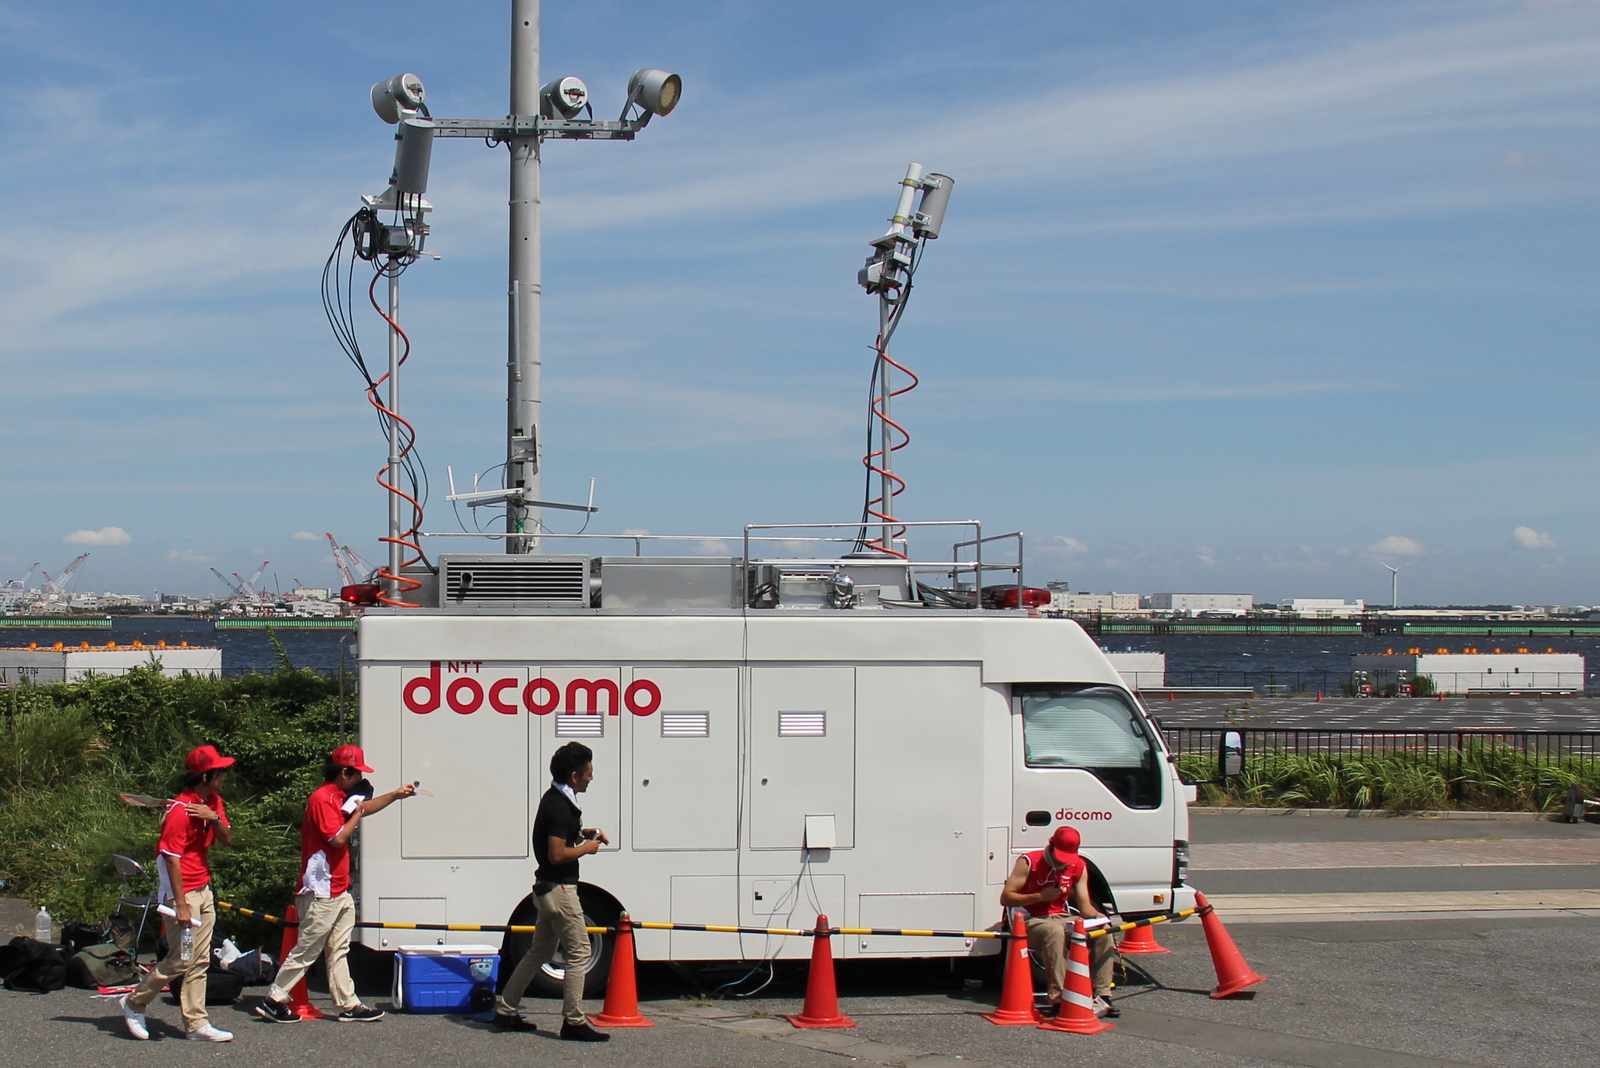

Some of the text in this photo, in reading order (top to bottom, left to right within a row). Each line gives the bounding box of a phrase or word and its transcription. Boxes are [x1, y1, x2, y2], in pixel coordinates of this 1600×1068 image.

[448, 661, 482, 673] NTT
[403, 661, 662, 716] docomo
[1055, 808, 1112, 820] docomo
